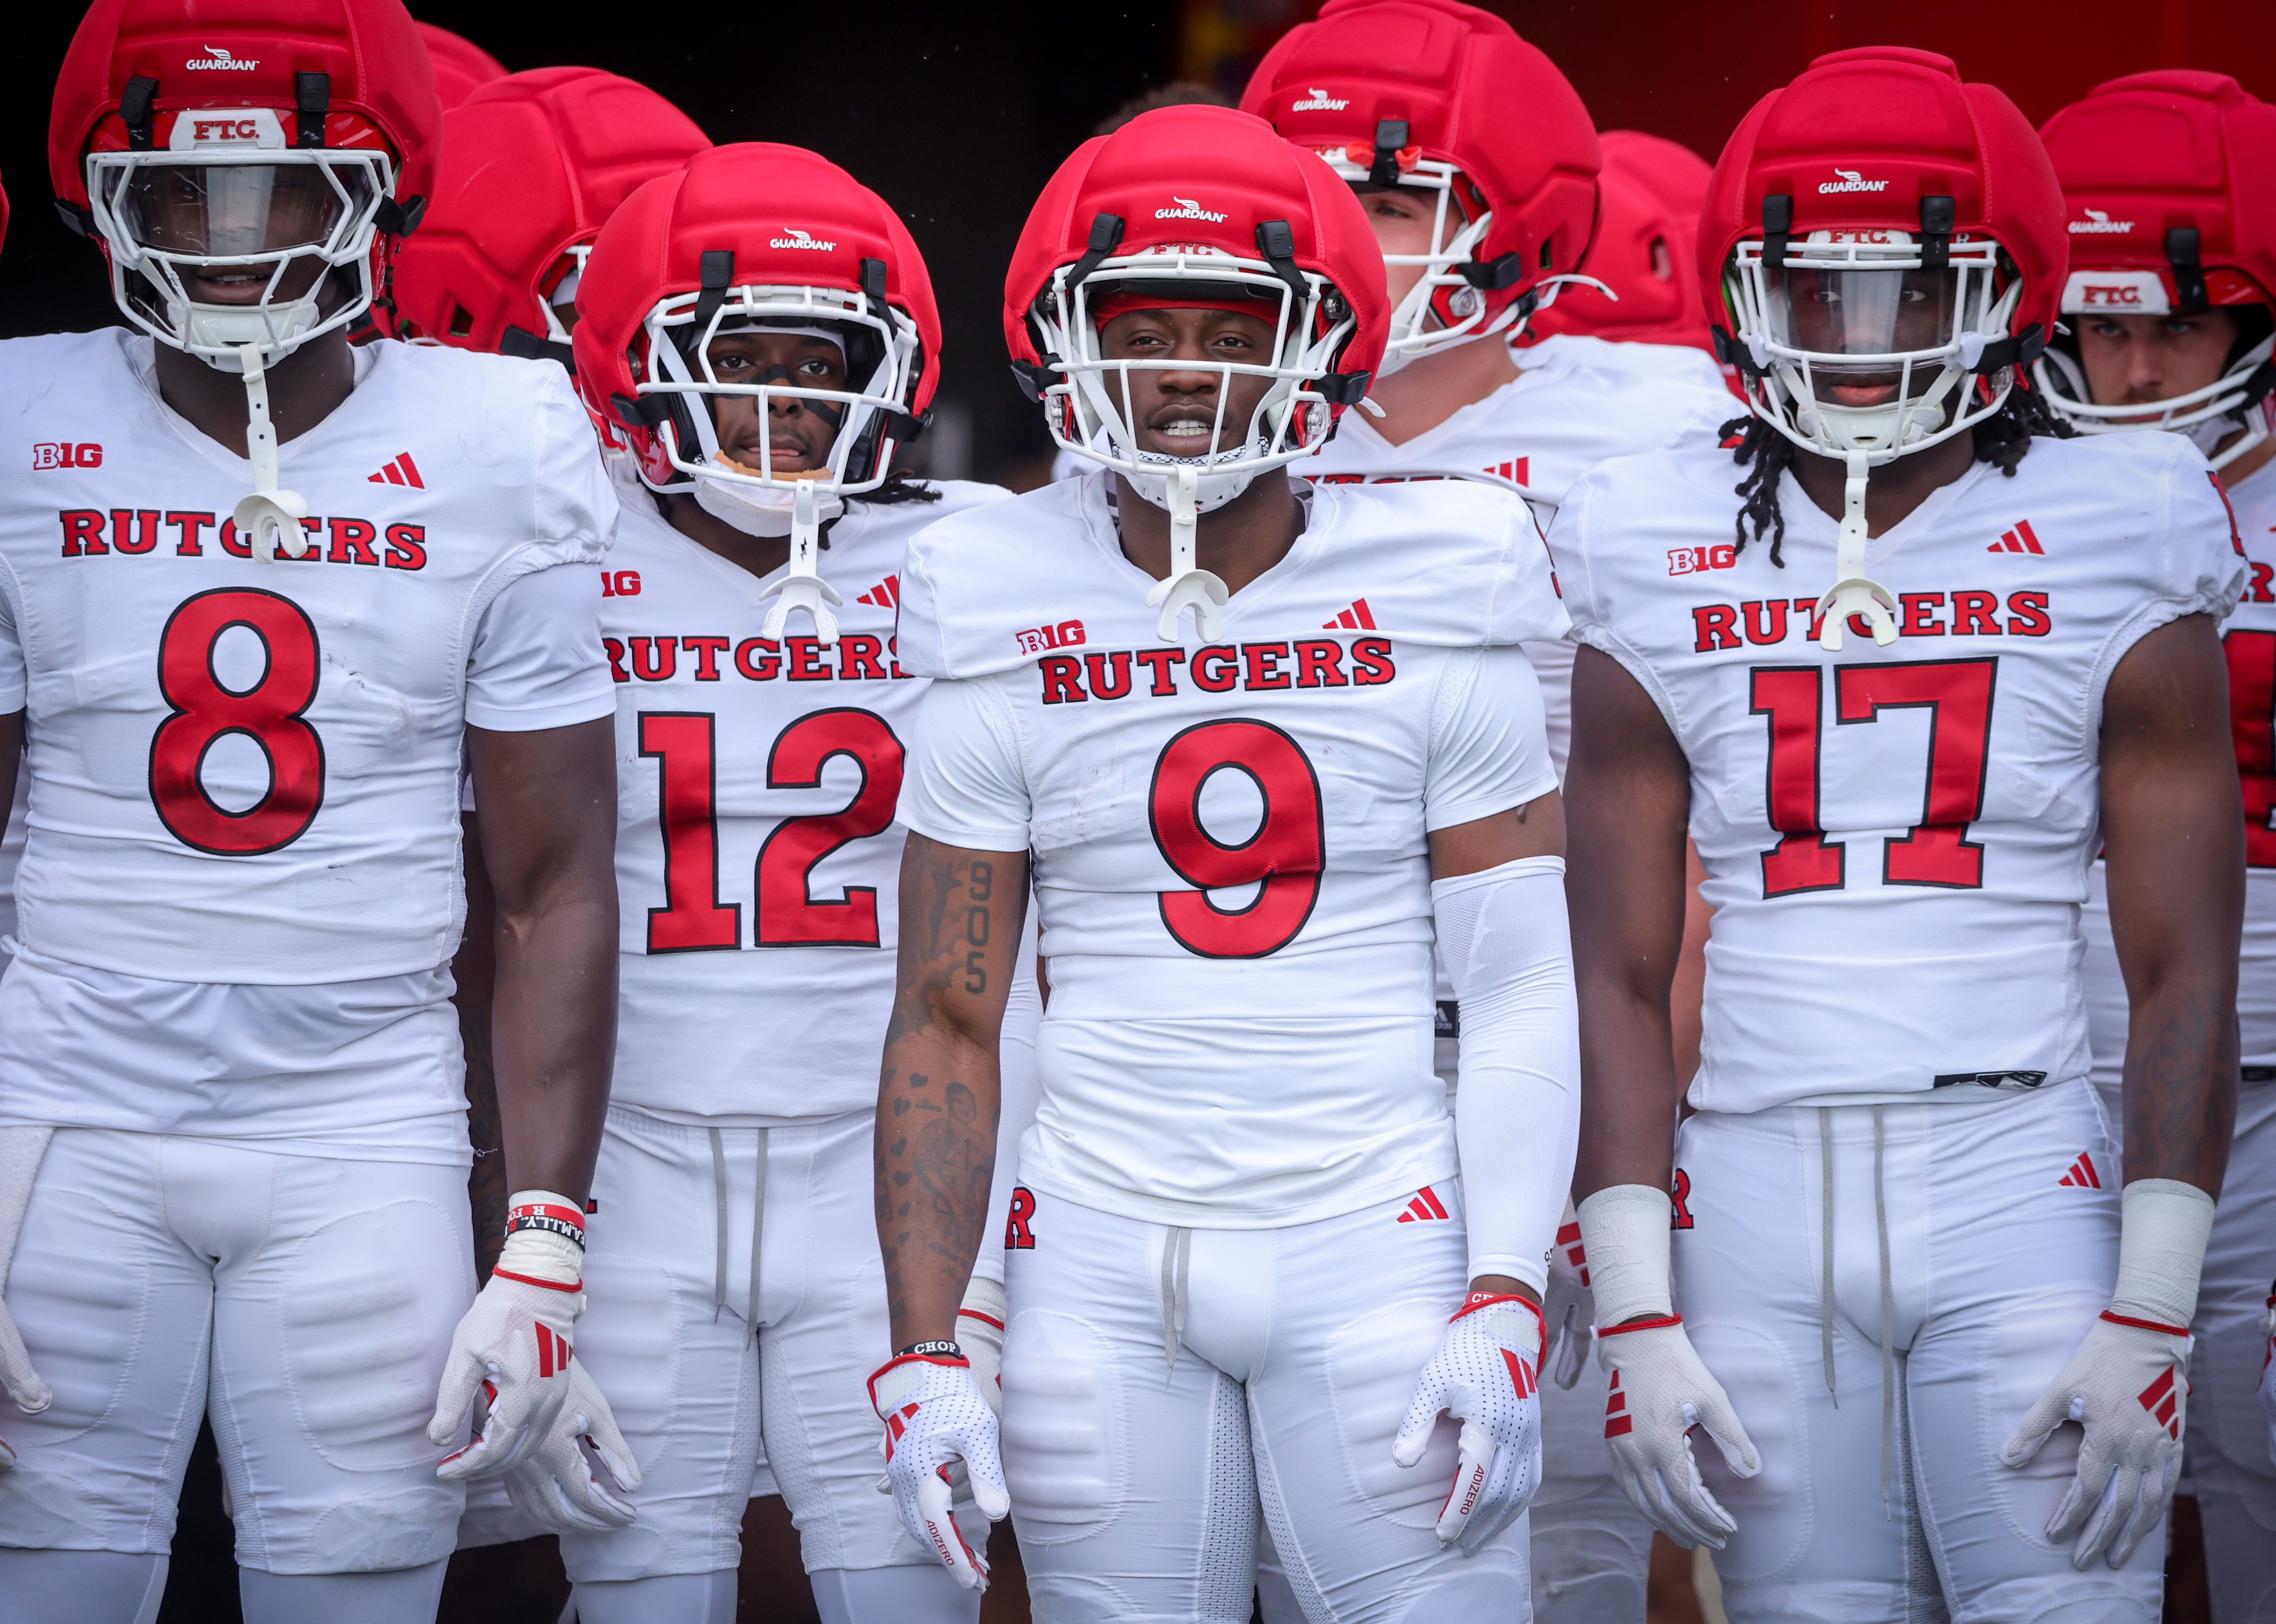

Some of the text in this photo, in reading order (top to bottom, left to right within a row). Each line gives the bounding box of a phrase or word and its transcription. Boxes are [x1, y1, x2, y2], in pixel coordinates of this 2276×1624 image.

[194, 120, 260, 139] F.T.C.
[1038, 637, 1396, 704] RUTGERS
[149, 586, 326, 856] 8
[1749, 655, 1999, 900] 17
[637, 707, 906, 955] 12
[1148, 717, 1326, 959] 9
[1005, 1187, 1036, 1250] R
[914, 1341, 956, 1354] CHOP
[1460, 1463, 1484, 1515] ADIZERO
[925, 1519, 955, 1566] ADIZERO
